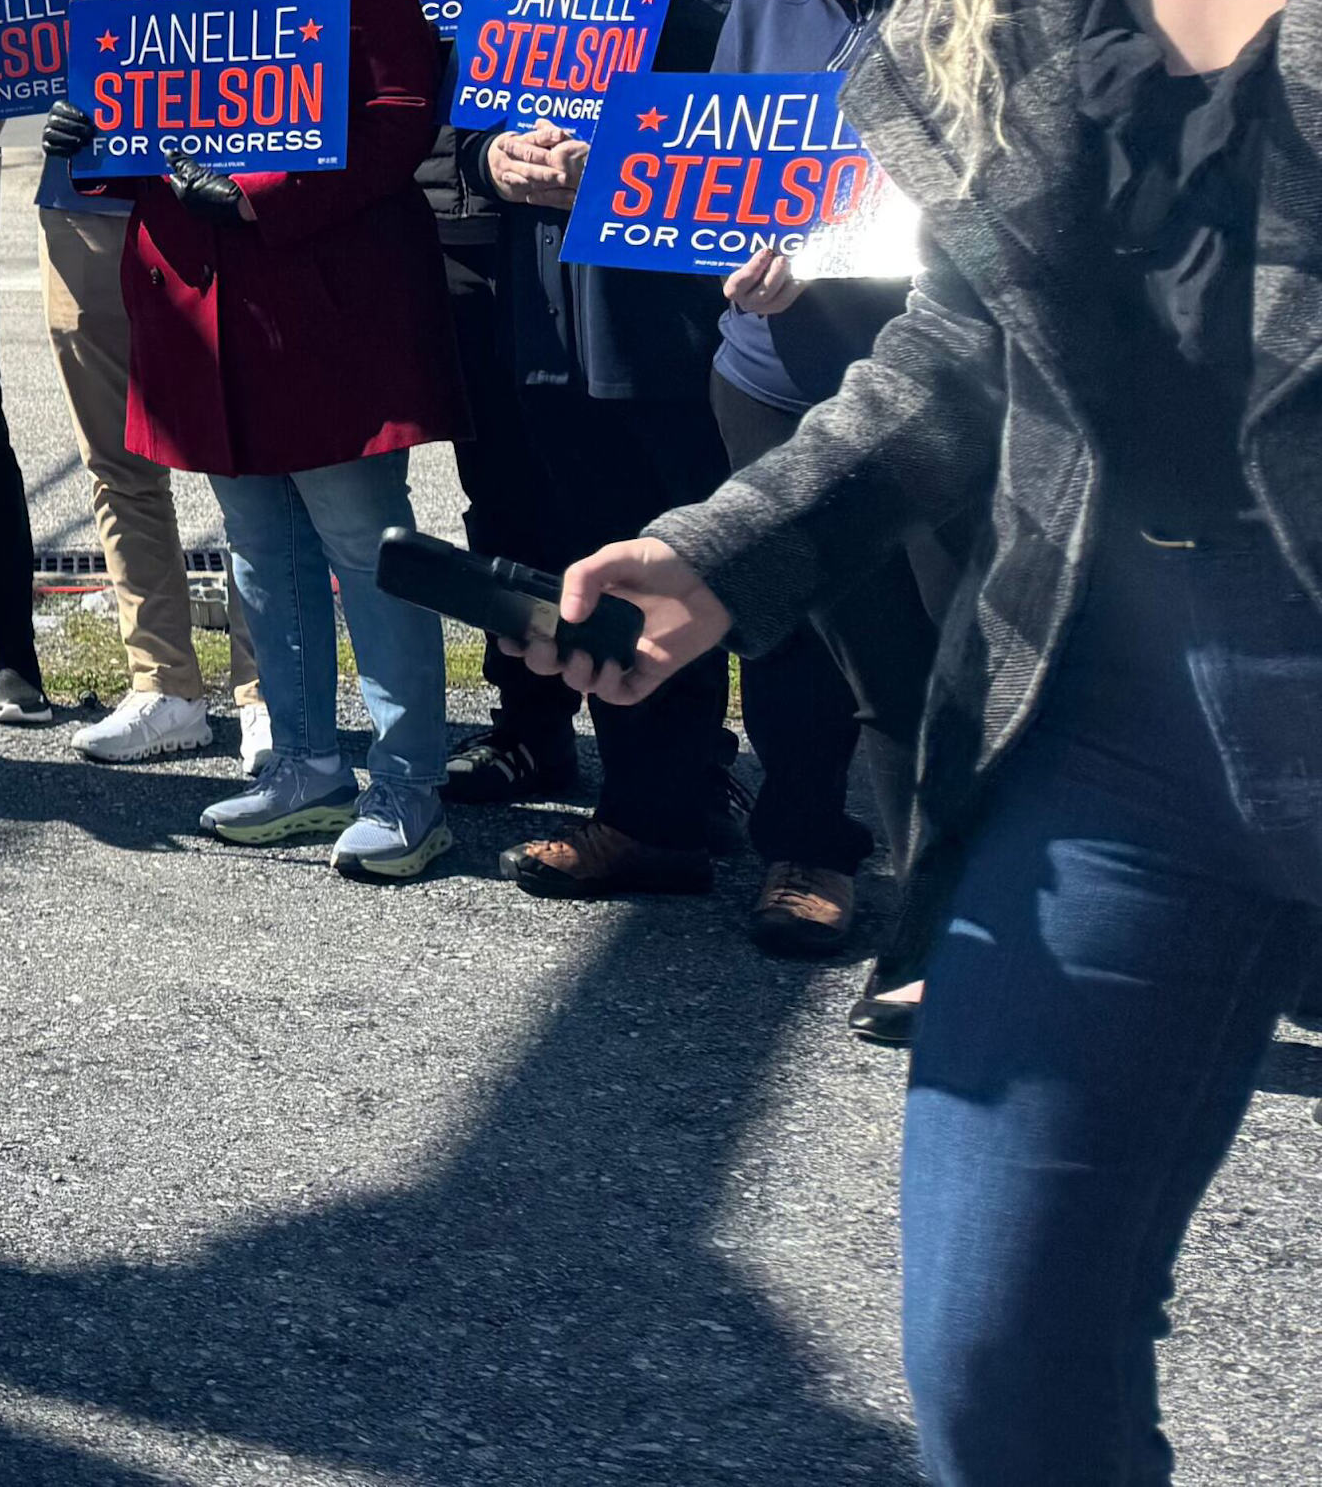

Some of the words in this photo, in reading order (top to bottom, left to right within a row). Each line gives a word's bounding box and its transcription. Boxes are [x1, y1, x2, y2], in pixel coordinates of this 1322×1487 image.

[120, 6, 297, 66] JANELLE
[470, 20, 647, 92] STELSON
[94, 62, 323, 131] STELSON
[459, 86, 508, 110] FOR
[663, 93, 869, 151] JANELL
[93, 135, 149, 156] FOR
[159, 130, 323, 154] CONGRESS
[611, 153, 881, 225] STELSO
[599, 221, 684, 248] FOR
